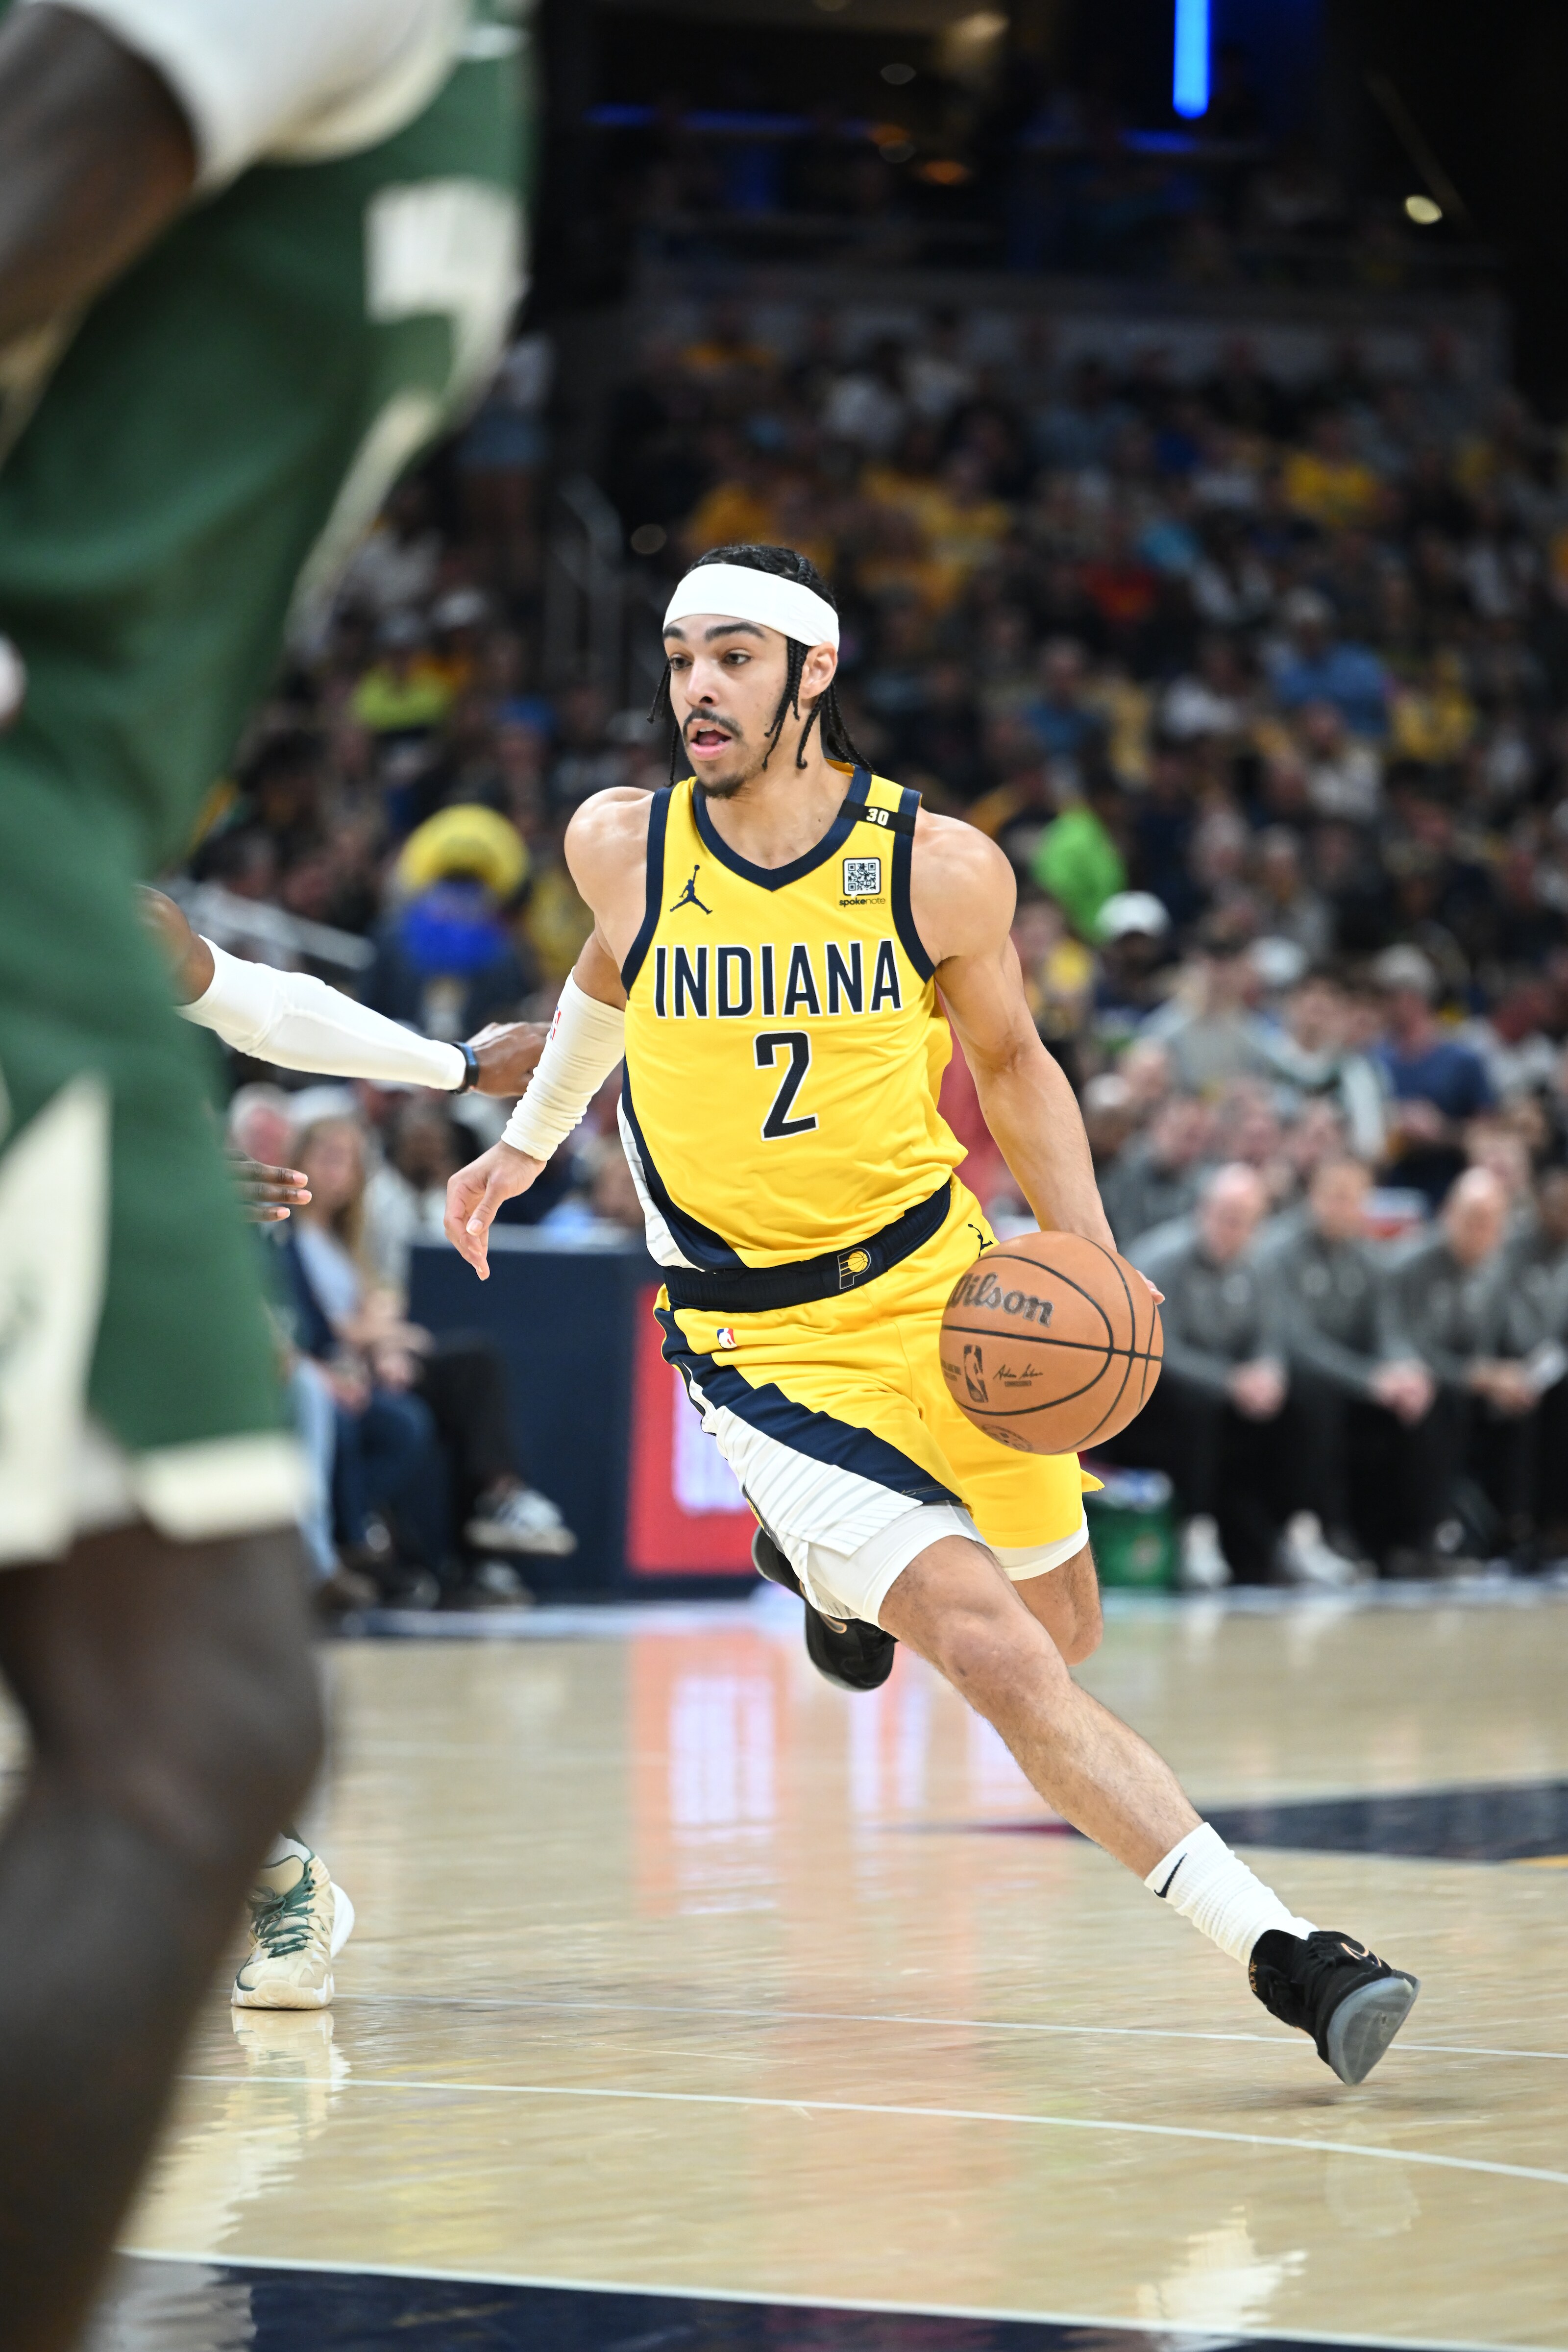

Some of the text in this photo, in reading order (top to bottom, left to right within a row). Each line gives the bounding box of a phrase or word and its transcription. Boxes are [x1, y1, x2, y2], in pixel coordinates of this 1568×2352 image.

[866, 808, 889, 826] 30
[839, 897, 886, 908] spokenote
[655, 938, 904, 1019] INDIANA
[753, 1030, 819, 1142] 2
